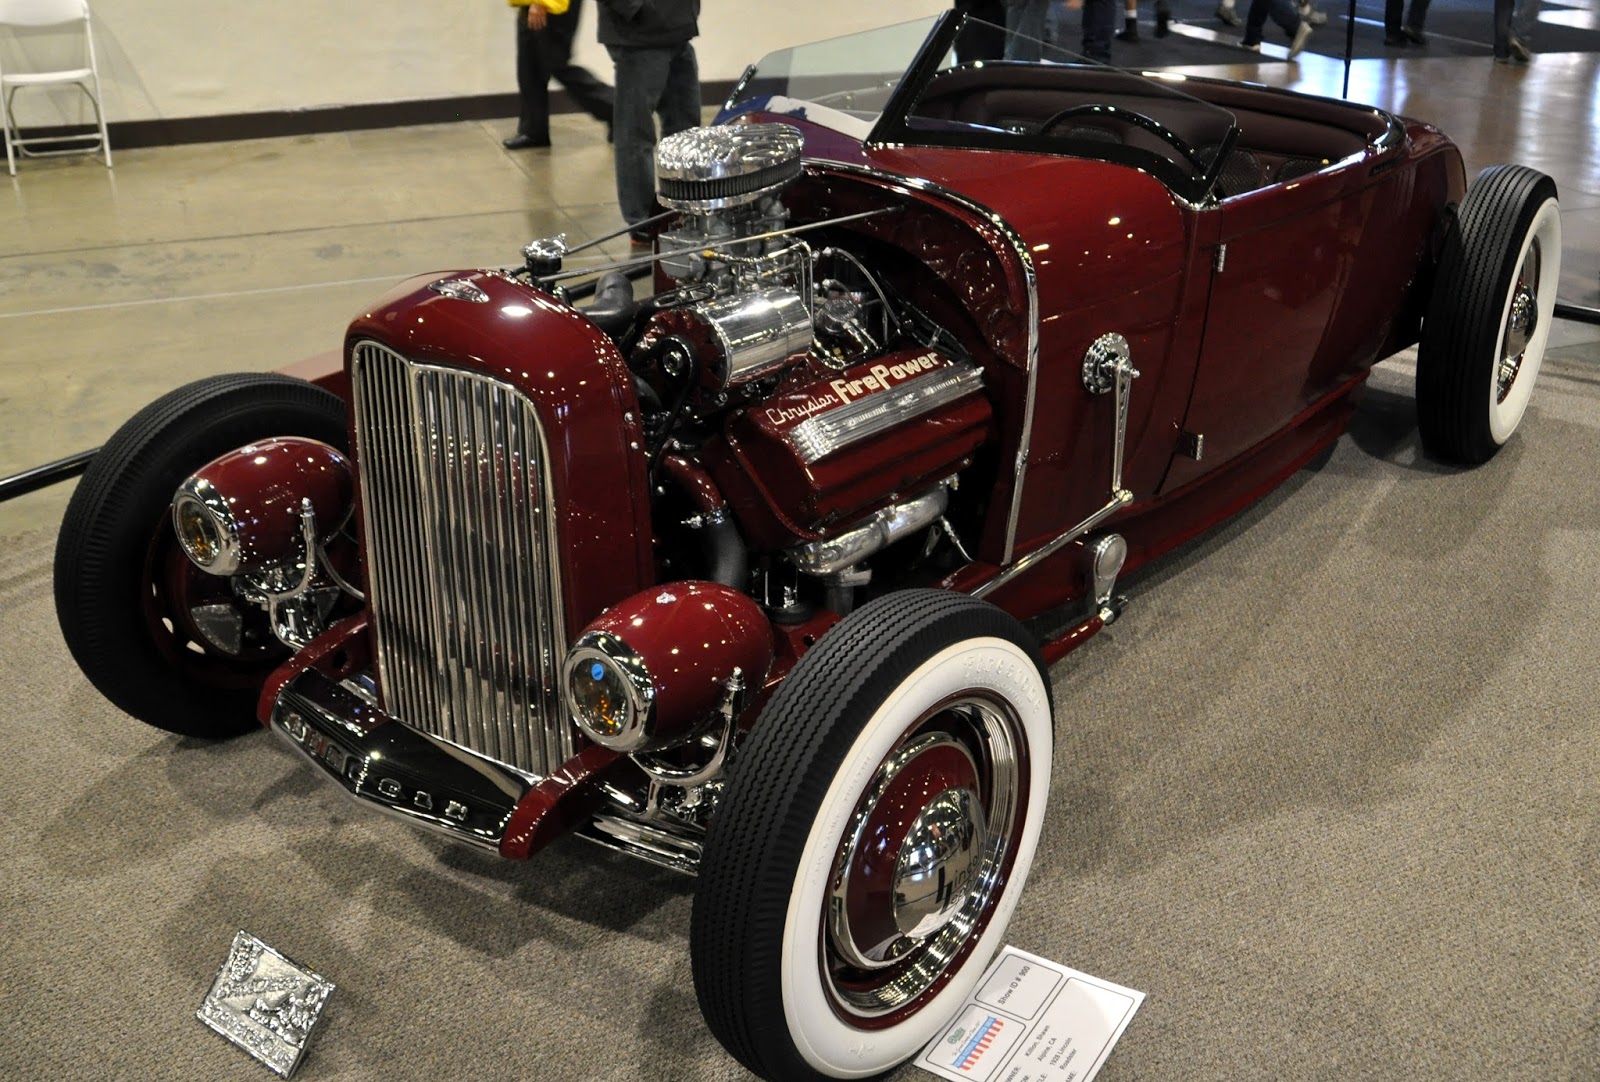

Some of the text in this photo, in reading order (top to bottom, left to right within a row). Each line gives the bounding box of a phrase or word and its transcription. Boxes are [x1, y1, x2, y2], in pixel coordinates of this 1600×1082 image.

[766, 351, 939, 425] Chrysler FirePower
[997, 989, 1013, 1005] Show
[1010, 981, 1019, 989] ID
[1048, 1037, 1057, 1045] CA
[1057, 1037, 1072, 1055] Lincoln
[1059, 1048, 1077, 1070] Roadster
